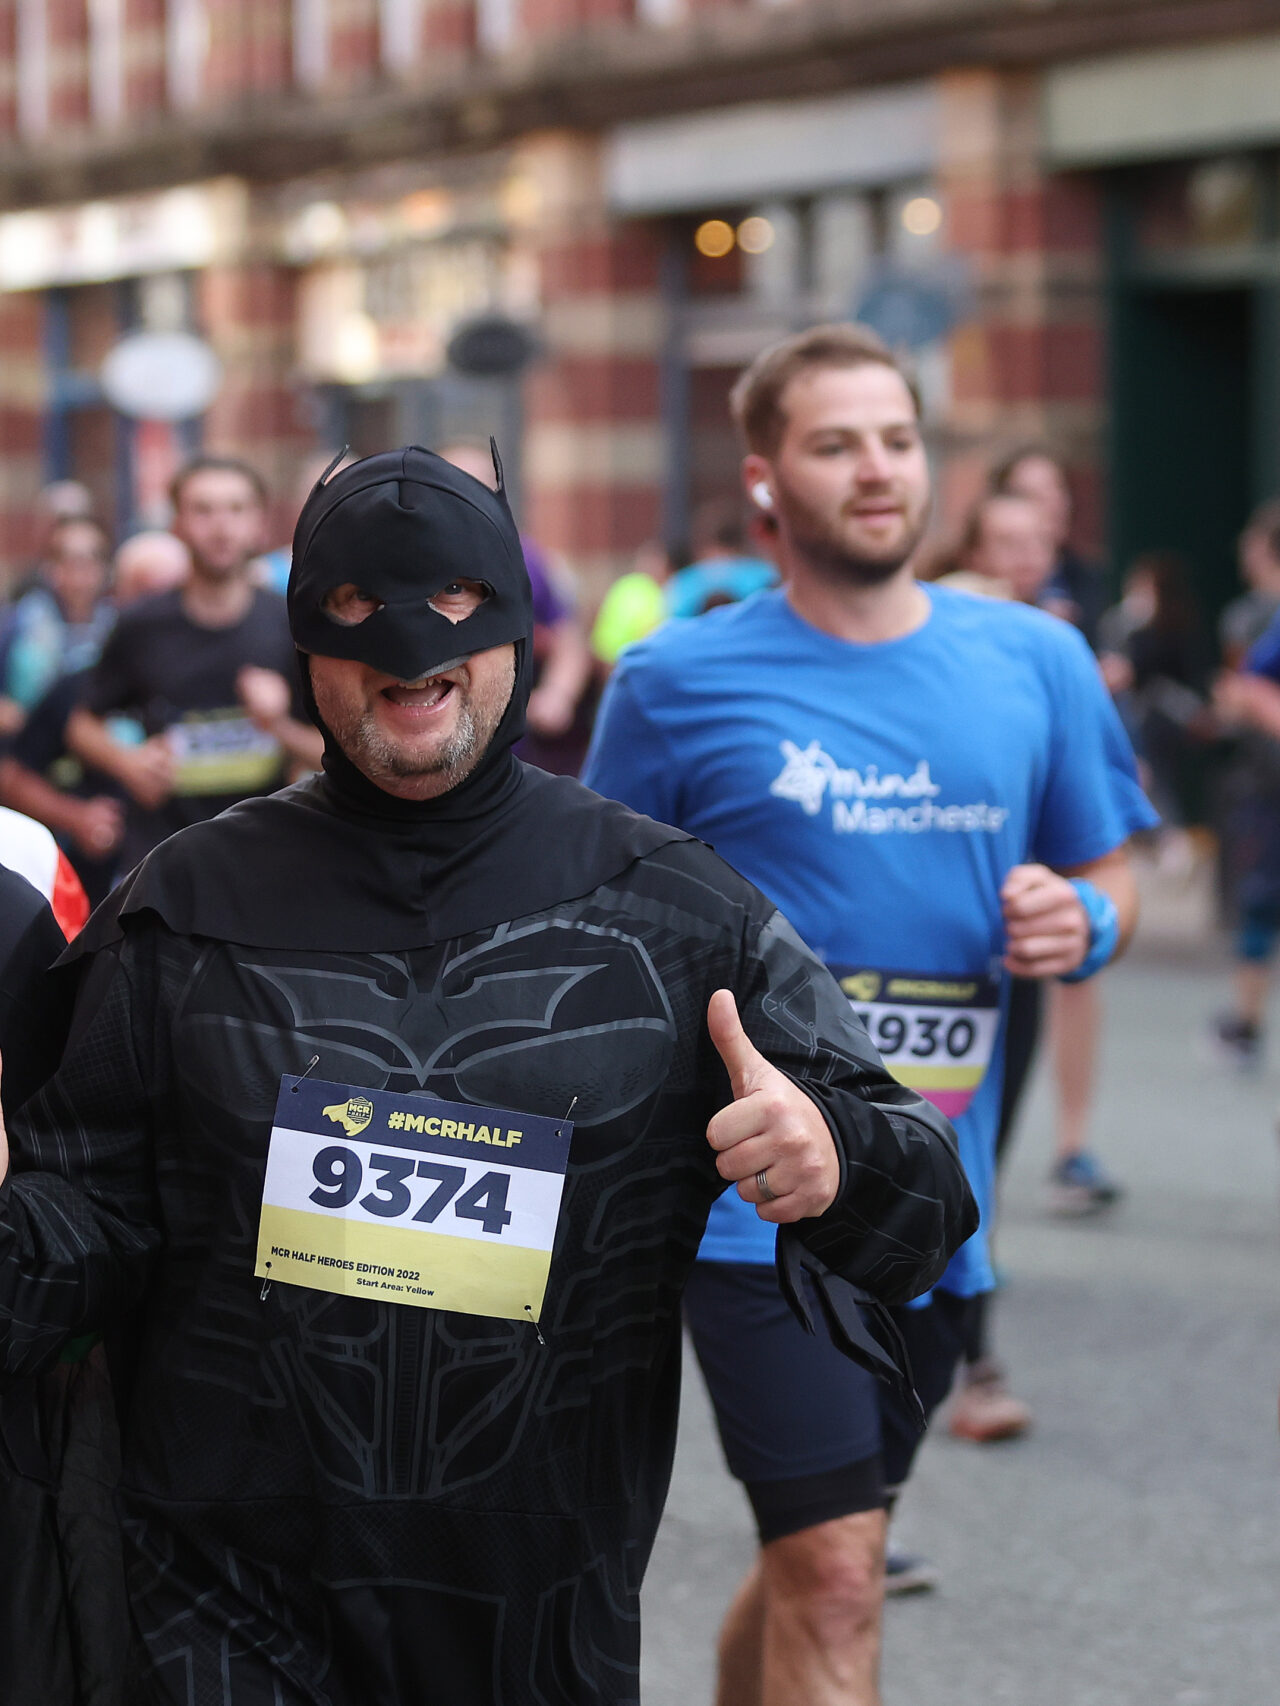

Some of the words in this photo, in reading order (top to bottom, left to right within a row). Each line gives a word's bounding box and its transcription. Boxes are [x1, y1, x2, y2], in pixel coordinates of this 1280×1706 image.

[830, 760, 940, 798] mind
[858, 1012, 976, 1058] 930
[349, 1104, 370, 1114] MCR
[388, 1111, 522, 1148] #MCRHALF
[308, 1146, 512, 1234] 9374
[271, 1246, 290, 1258] MCR
[291, 1250, 316, 1263] HALF
[317, 1255, 355, 1270] HEROES
[356, 1263, 395, 1277] EDITION
[396, 1269, 420, 1281] 2022
[356, 1277, 379, 1287] Start
[380, 1282, 404, 1292] Area:
[406, 1285, 435, 1296] Yellow
